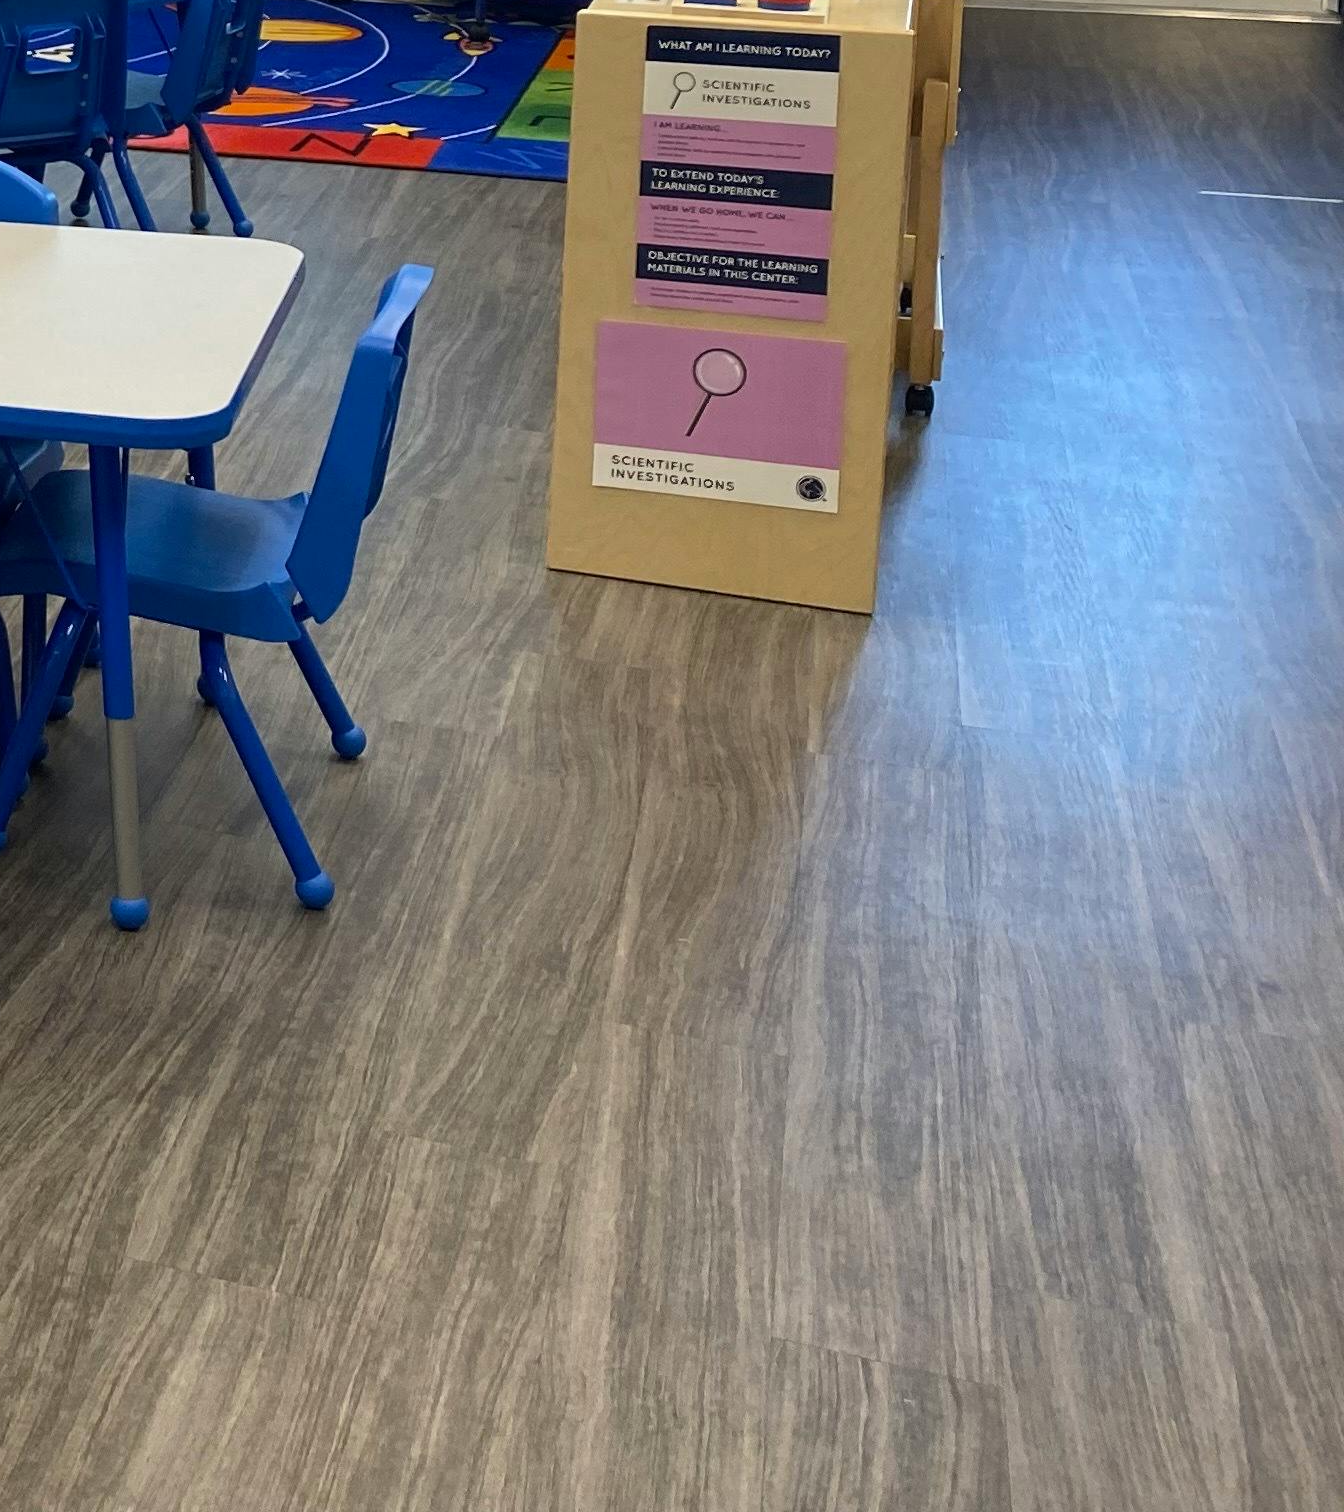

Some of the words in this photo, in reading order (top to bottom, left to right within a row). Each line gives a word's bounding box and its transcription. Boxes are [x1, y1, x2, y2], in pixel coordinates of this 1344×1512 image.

[658, 40, 692, 52] WHAT
[695, 41, 713, 53] AM
[716, 43, 720, 53] I
[722, 43, 782, 56] LEARNING
[785, 46, 831, 59] TODAY?
[702, 79, 775, 93] SCIENTIFIC
[702, 93, 811, 110] INVESTIGATIONS
[658, 121, 672, 129] AM
[652, 168, 668, 178] TO
[670, 169, 715, 182] EXTEND
[717, 171, 764, 185] TODAY'S
[651, 180, 707, 195] LEARNING
[650, 203, 679, 212] WHEN
[682, 206, 696, 214] WE
[699, 207, 713, 215] GO
[748, 211, 763, 219] WE
[648, 250, 710, 264] OBJECTIVE
[712, 255, 735, 266] FOR
[738, 258, 759, 269] THE
[762, 260, 818, 274] LEARNING
[647, 263, 706, 276] MATERIALS
[709, 268, 721, 277] IN
[724, 269, 749, 280] THIS
[752, 273, 799, 285] CENTER:
[611, 454, 695, 473] SCIENTIFIC
[611, 468, 735, 492] INVESTIGATIONS
